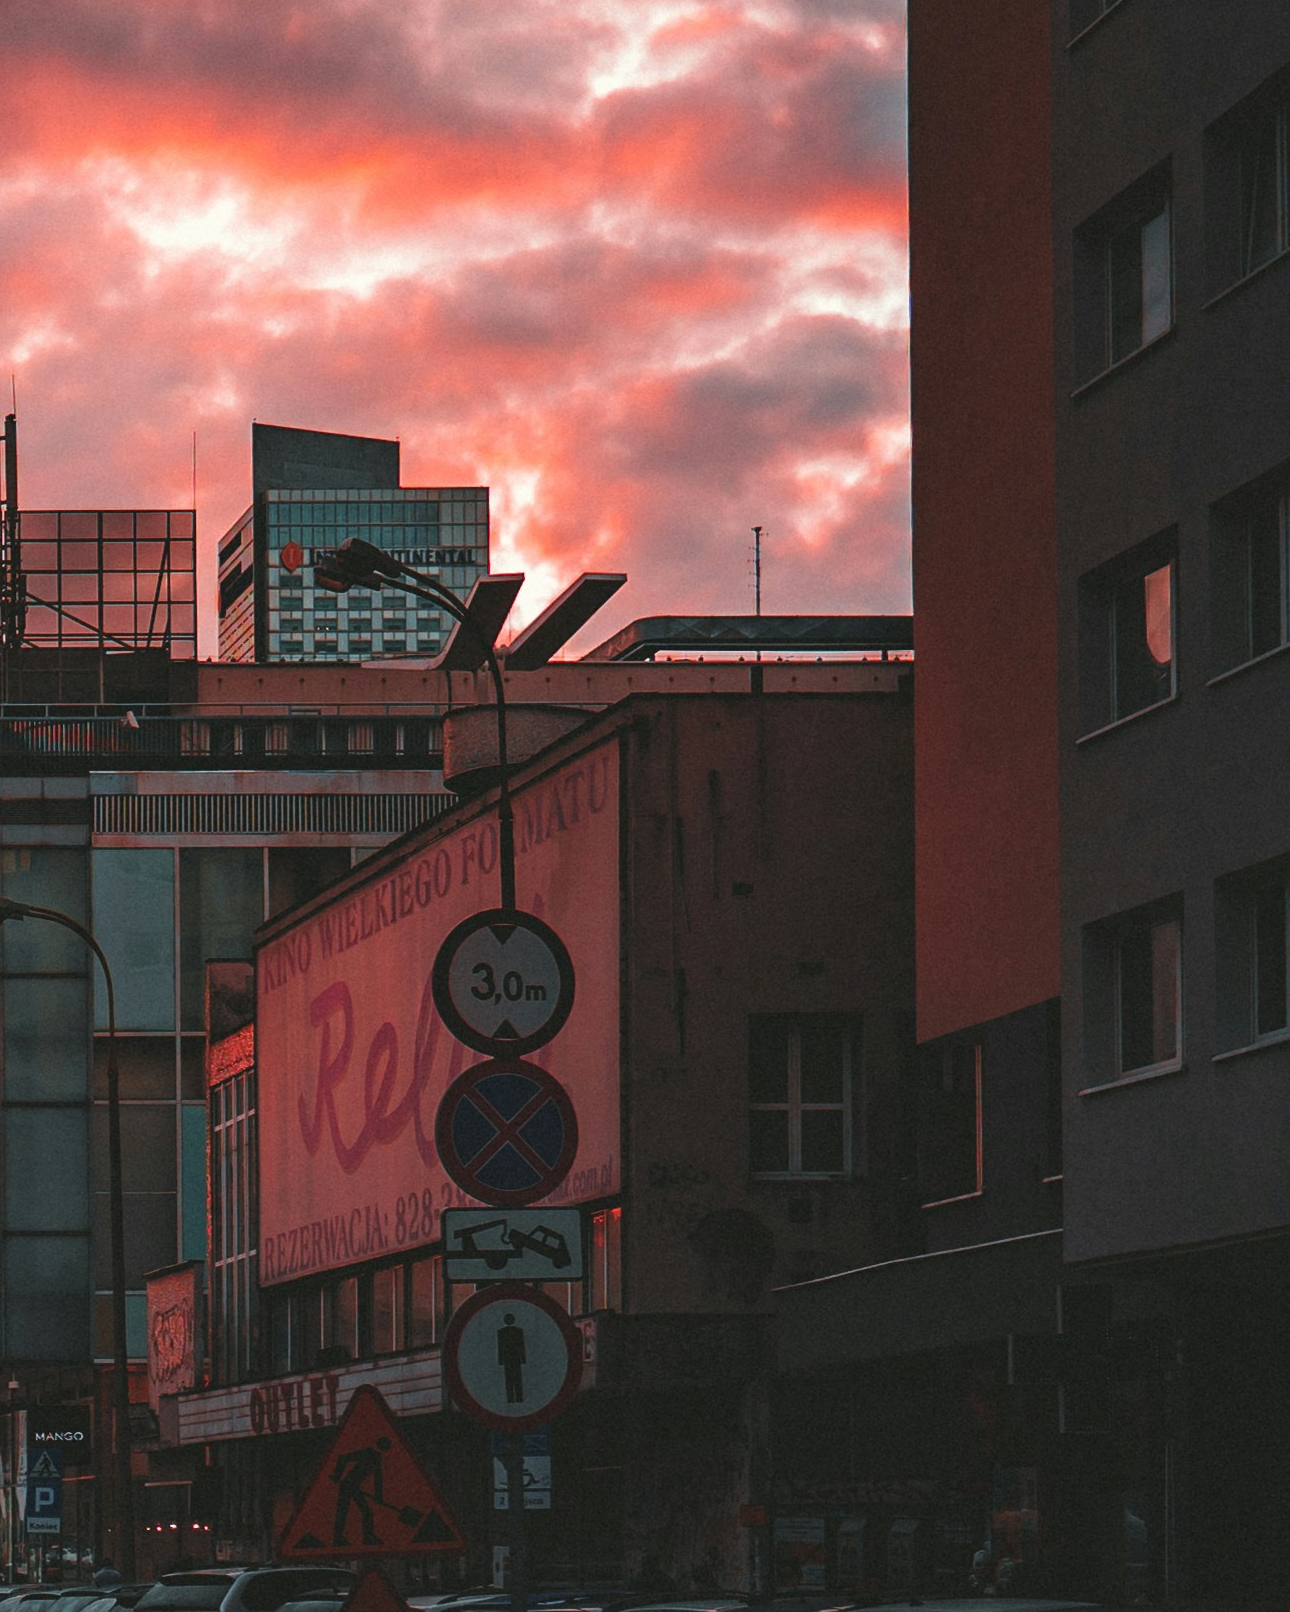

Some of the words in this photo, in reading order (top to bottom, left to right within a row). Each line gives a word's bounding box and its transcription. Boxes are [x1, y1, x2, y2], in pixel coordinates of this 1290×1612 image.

[309, 548, 476, 565] INNTINENTAL
[263, 930, 313, 995] KINO
[317, 848, 453, 961] WIELKIEGO
[461, 755, 609, 886] FOMATU
[264, 1201, 390, 1283] REZERWACJA:
[249, 1374, 340, 1435] OUTLET
[34, 1431, 84, 1442] MANGO
[35, 1486, 55, 1513] P
